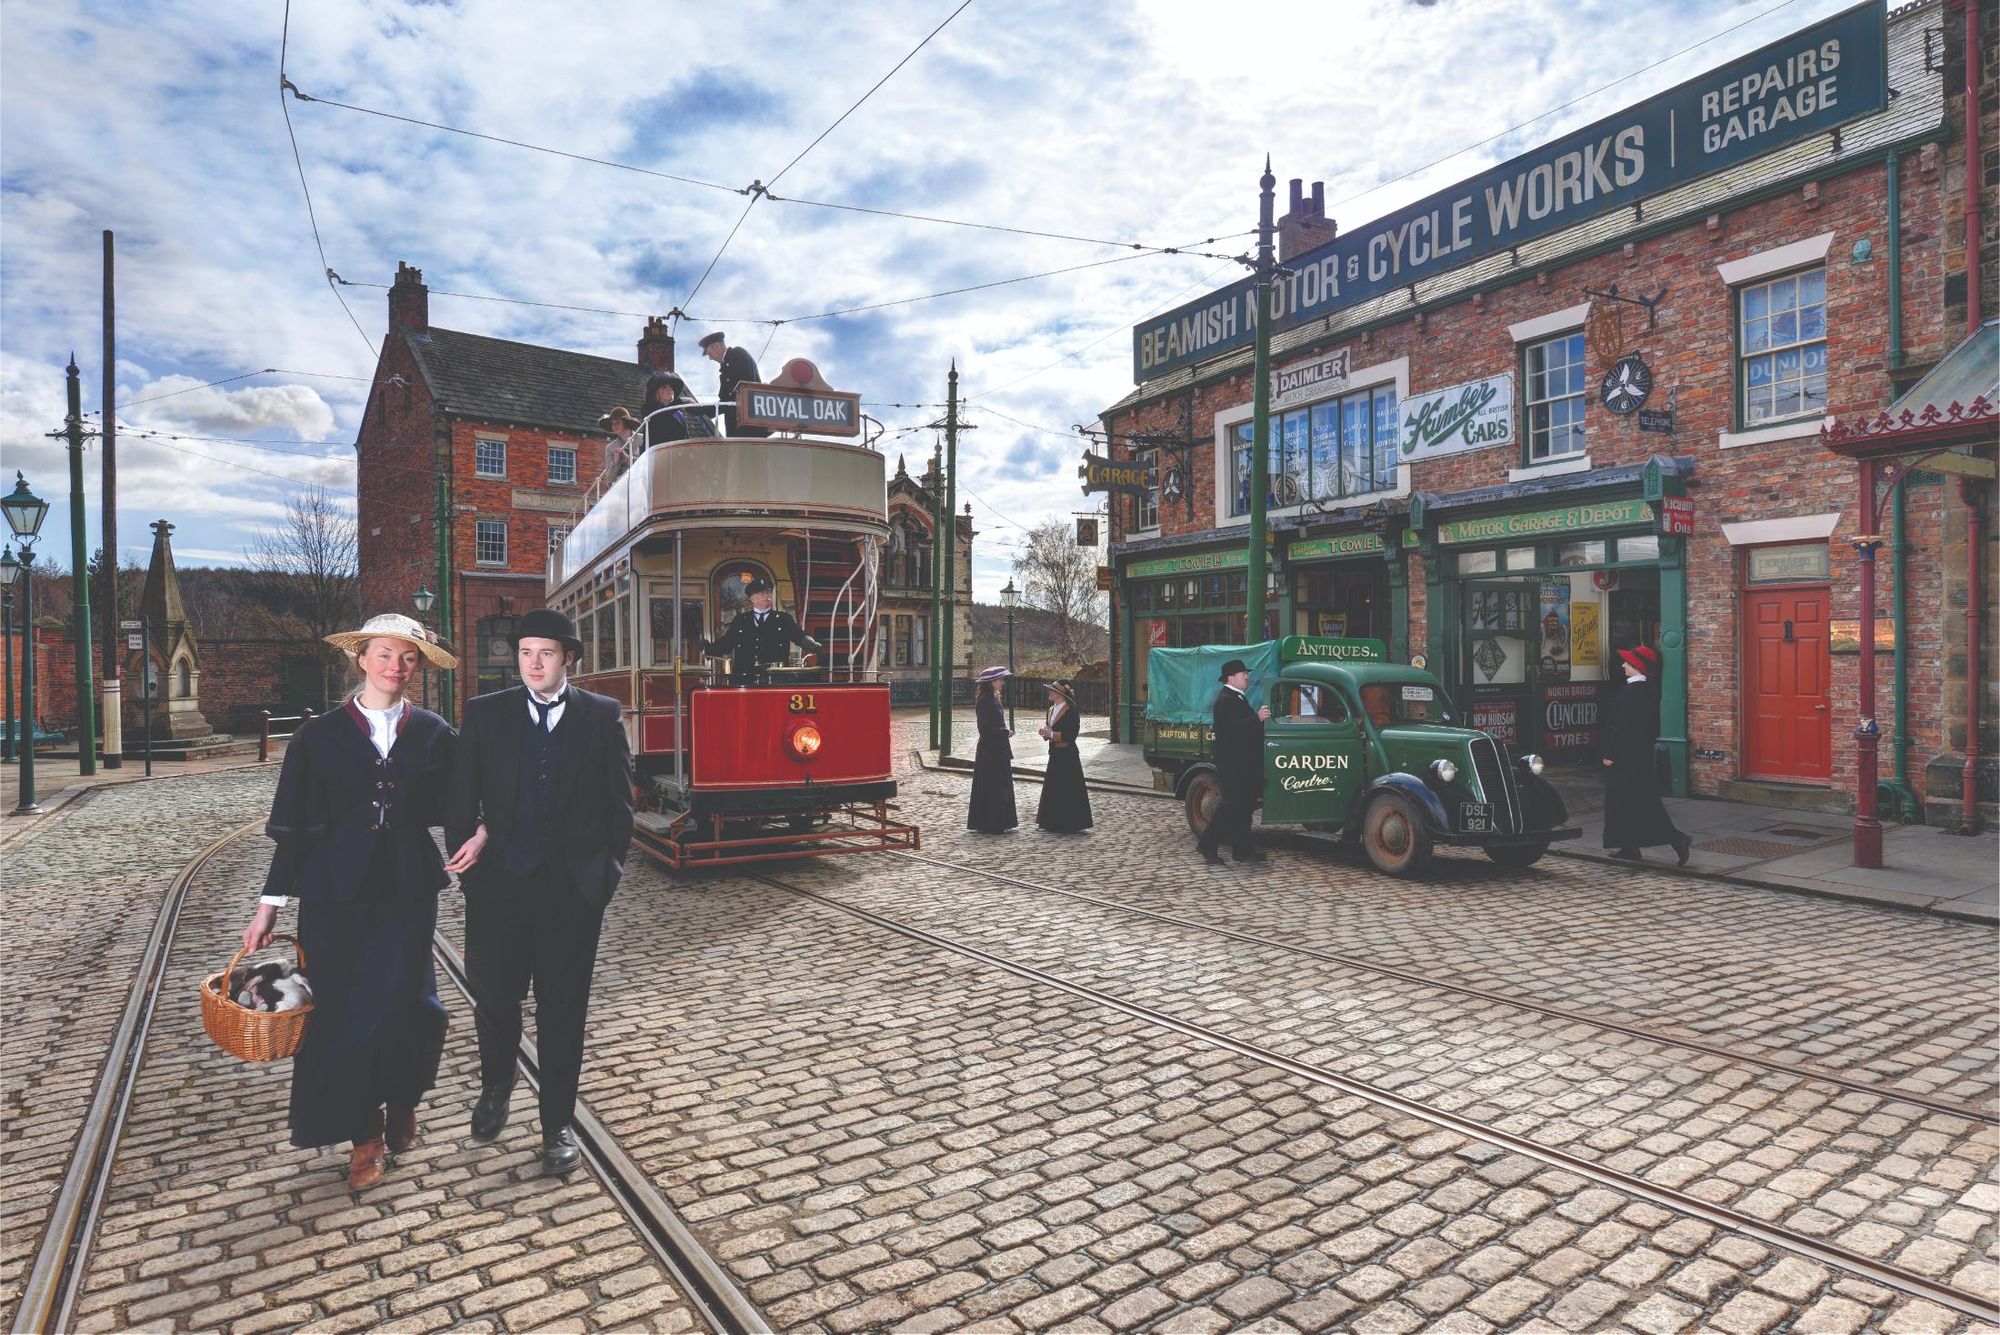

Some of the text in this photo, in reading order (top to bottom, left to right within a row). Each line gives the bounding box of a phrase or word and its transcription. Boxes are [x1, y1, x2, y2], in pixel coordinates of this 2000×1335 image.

[1702, 39, 1840, 122] REPAIRS
[1703, 75, 1837, 154] GARAGE
[1141, 124, 1645, 370] BEAMISH MOTOR & CYCLE WORKS
[1280, 360, 1342, 392] DAIMLER
[753, 395, 847, 420] ROYAL OAK
[1401, 382, 1498, 455] Humber
[1640, 415, 1671, 427] TELEPHONE
[1461, 418, 1508, 445] CARS
[1088, 464, 1148, 489] GARAGE
[1662, 497, 1694, 512] Vacuum
[1459, 520, 1505, 538] MOTOR
[1508, 514, 1563, 533] GARAGE
[1579, 506, 1633, 525] DEPOT
[1673, 522, 1692, 534] Oils
[1340, 537, 1373, 551] COWIE
[1547, 686, 1596, 697] NORTH BRITISH
[789, 694, 817, 712] 31
[1473, 711, 1515, 727] NEW HUDSON
[1546, 700, 1598, 730] CLINCHER
[1158, 730, 1187, 739] SKIPTON
[1554, 732, 1590, 746] TYRES
[1275, 755, 1349, 771] GARDEN
[1465, 804, 1489, 816] DSL
[1467, 818, 1486, 830] 921
